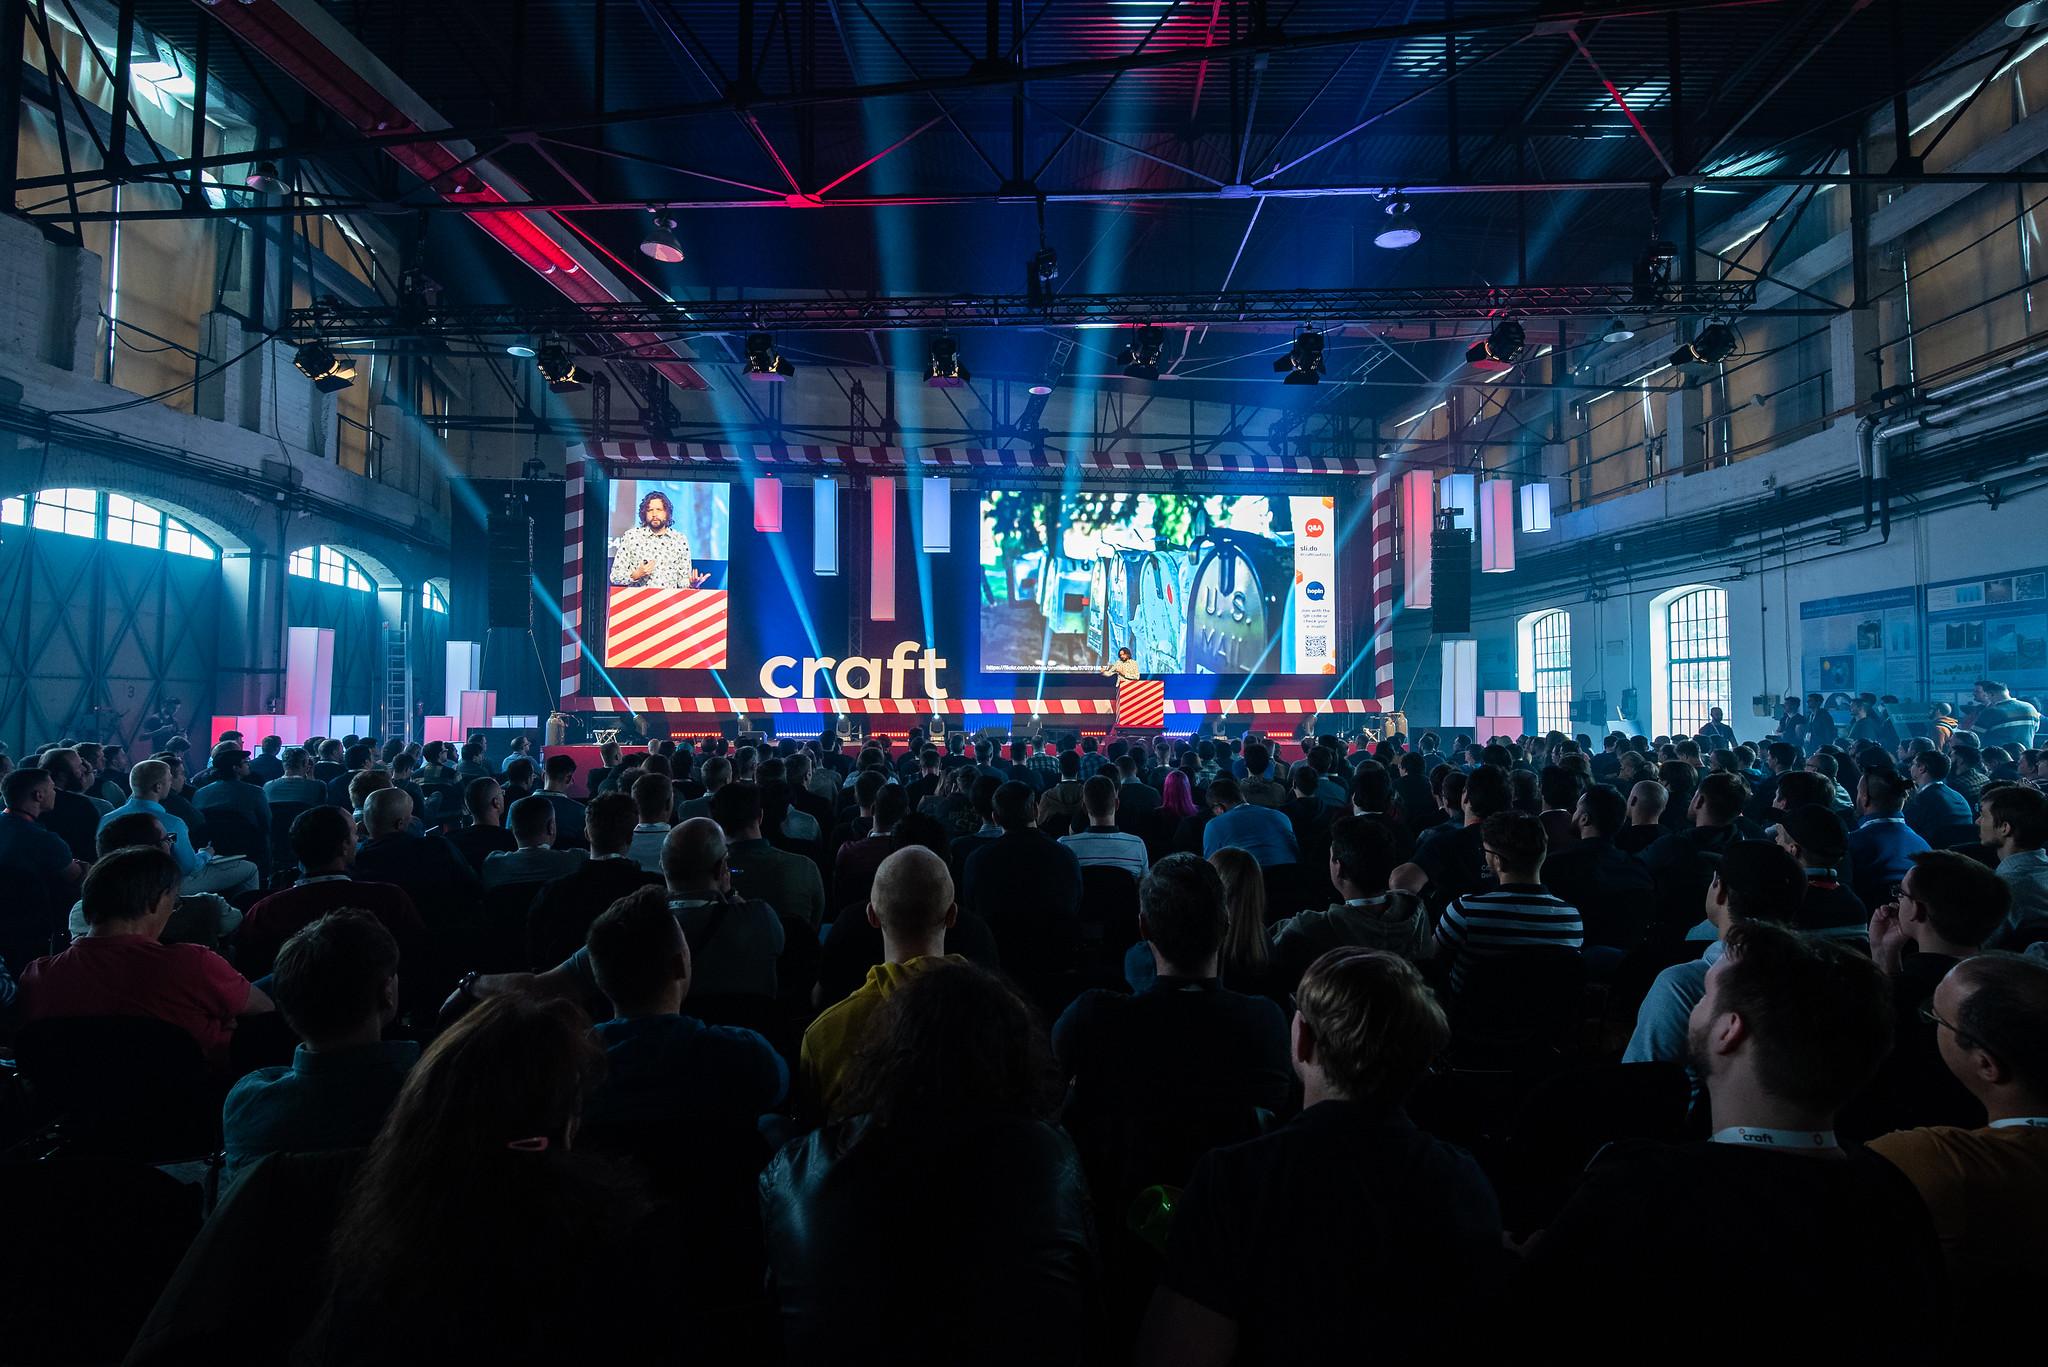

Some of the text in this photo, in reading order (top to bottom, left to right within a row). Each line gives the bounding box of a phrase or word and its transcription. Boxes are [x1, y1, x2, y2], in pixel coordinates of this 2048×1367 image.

[1307, 525, 1323, 533] Q&A
[759, 640, 949, 699] craft
[1743, 1133, 1774, 1144] craft
